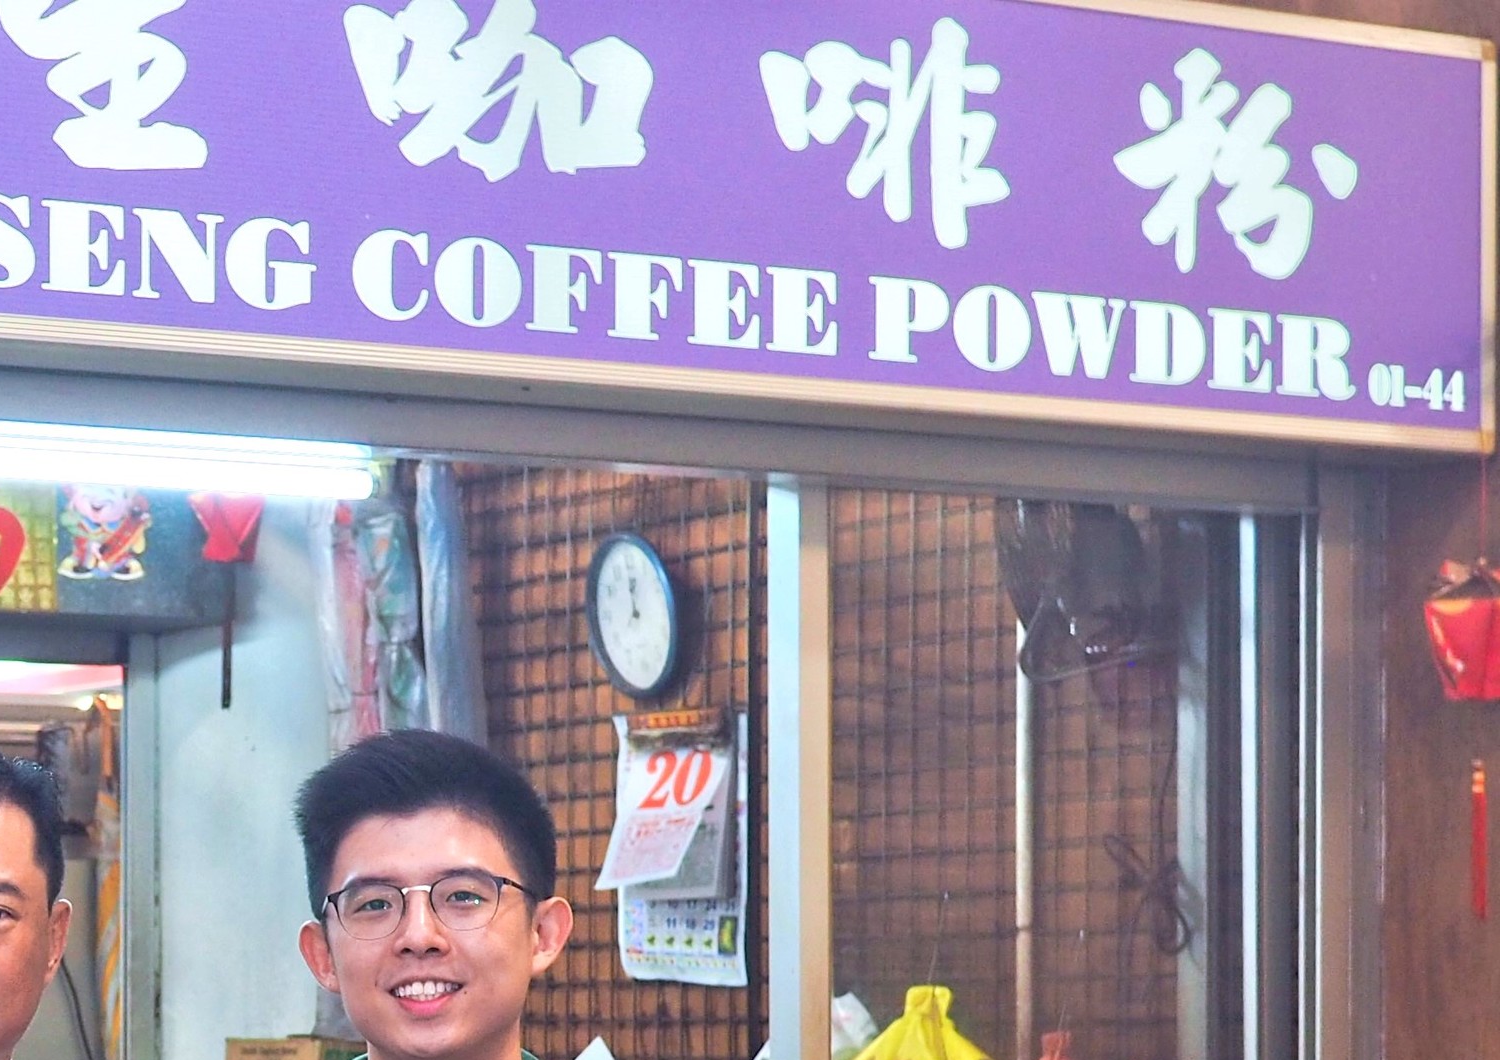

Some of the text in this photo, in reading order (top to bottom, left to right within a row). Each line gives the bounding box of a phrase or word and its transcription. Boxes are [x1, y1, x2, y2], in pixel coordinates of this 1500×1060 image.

[352, 227, 840, 357] COFFEE
[868, 275, 1356, 400] POWDER
[1367, 362, 1465, 412] 01-44
[638, 749, 713, 810] 20
